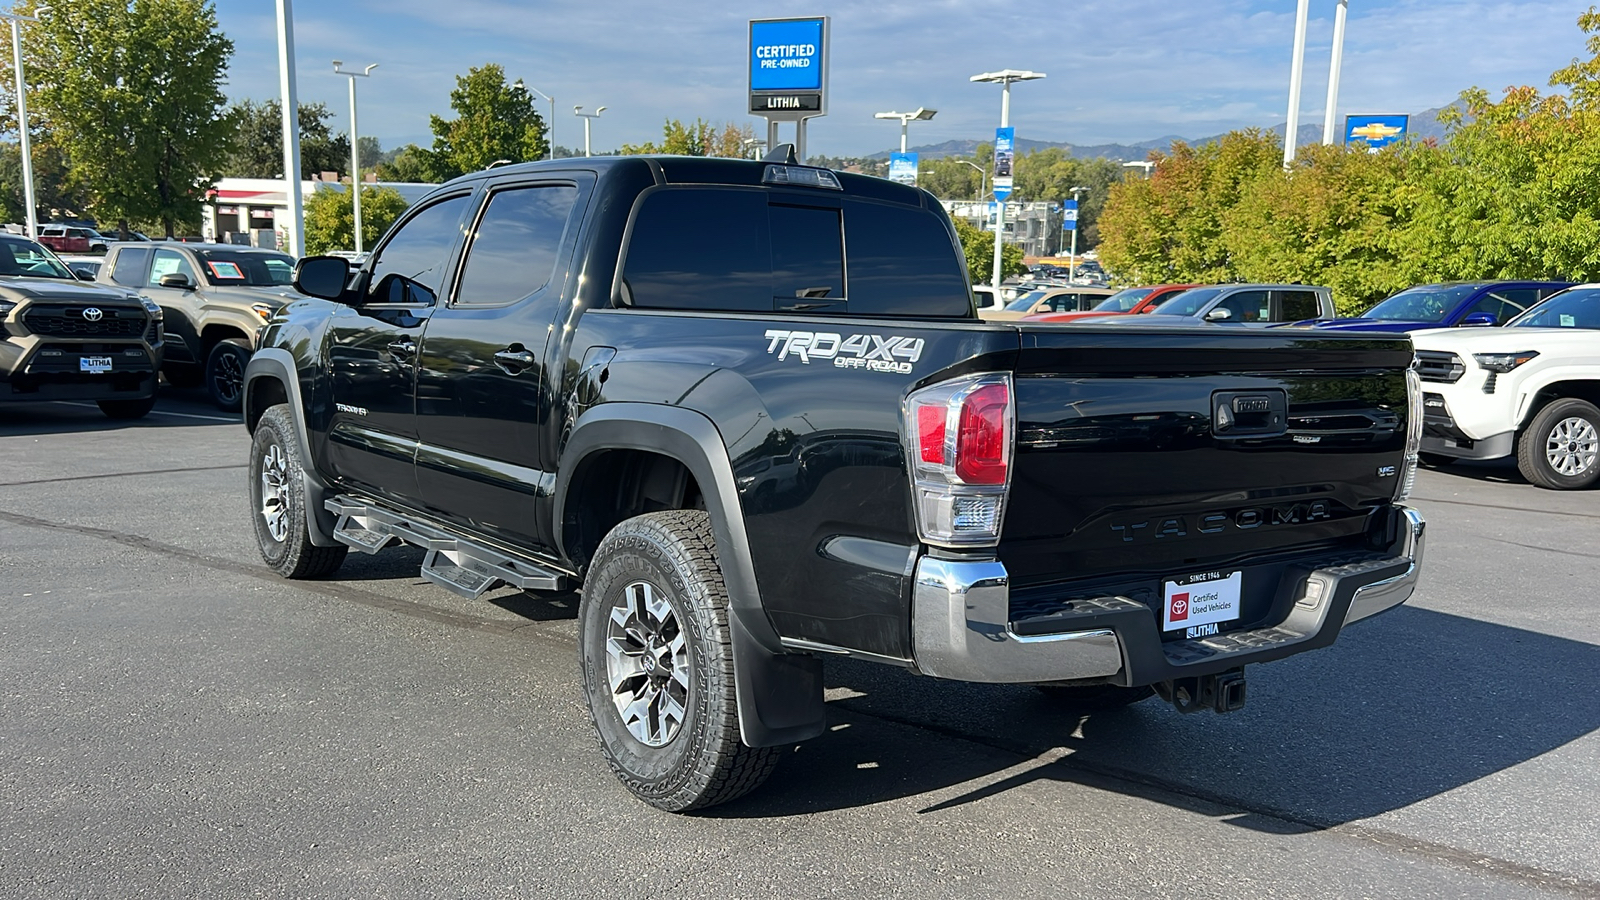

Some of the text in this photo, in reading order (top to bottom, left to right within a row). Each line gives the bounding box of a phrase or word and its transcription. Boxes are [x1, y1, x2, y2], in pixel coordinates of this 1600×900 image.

[756, 44, 815, 58] CERTIFIED
[760, 58, 810, 69] PRE-OWNED
[767, 97, 800, 109] LITHIA
[764, 329, 925, 364] TRD 4X4
[88, 359, 111, 367] LITHIA
[834, 356, 913, 375] OFF ROAD
[1238, 400, 1270, 411] TOYOTA
[1377, 465, 1395, 477] V6
[1110, 501, 1330, 541] TACOMA
[1189, 571, 1220, 583] SINCE 1946
[1193, 593, 1218, 603] Certified
[1192, 602, 1231, 614] Used Vehicles
[1194, 623, 1219, 637] LITHIA
